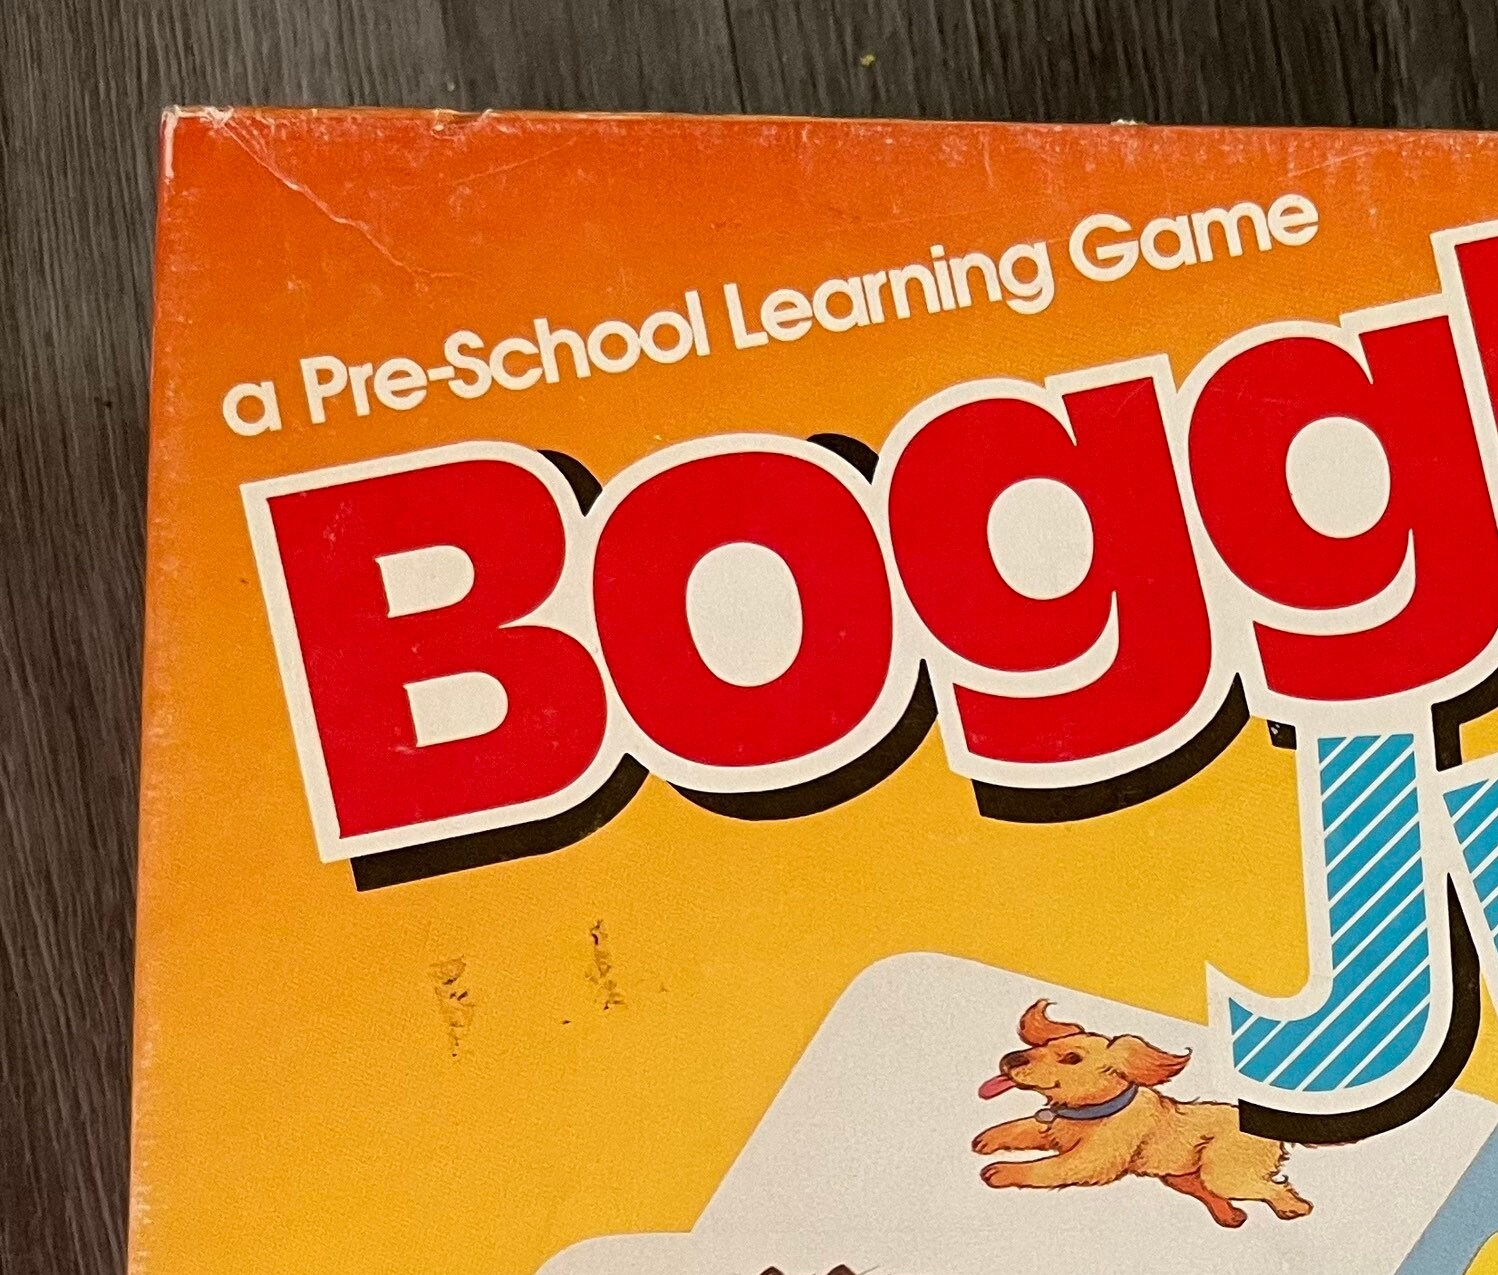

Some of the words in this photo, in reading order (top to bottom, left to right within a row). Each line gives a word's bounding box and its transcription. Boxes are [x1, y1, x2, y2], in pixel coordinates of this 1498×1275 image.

[222, 380, 282, 437] a
[299, 290, 711, 425] Pre-School
[723, 241, 1057, 350] Learning
[1068, 193, 1319, 283] Game
